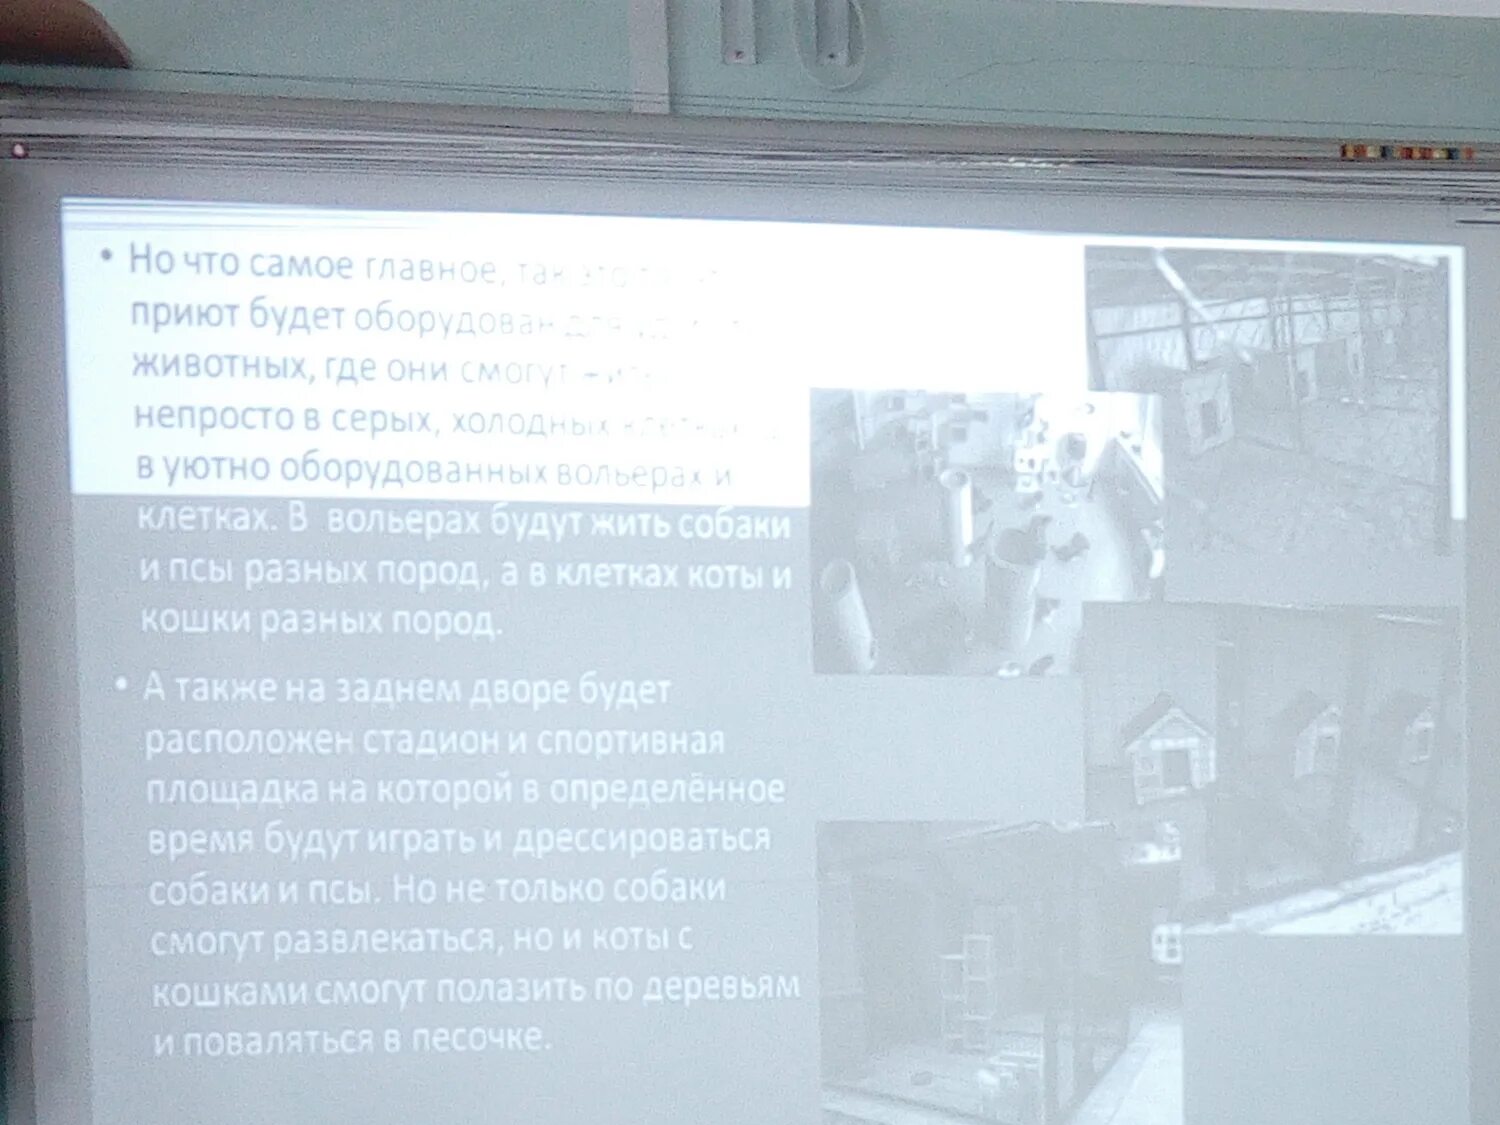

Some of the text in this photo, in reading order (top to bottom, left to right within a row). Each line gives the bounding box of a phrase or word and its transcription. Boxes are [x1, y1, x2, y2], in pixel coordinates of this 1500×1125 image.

[130, 242, 175, 276] Но
[183, 250, 239, 277] что
[249, 251, 354, 280] самое
[366, 256, 505, 288] главное,
[131, 301, 239, 333] приют
[249, 296, 346, 335] будет
[355, 302, 554, 340] оборудован
[133, 352, 316, 384] животных,
[326, 358, 377, 385] где
[388, 358, 448, 382] они
[461, 361, 565, 388] смогут
[135, 404, 294, 436] непросто
[304, 408, 321, 431] в
[332, 409, 440, 438] серых,
[452, 411, 609, 439] холодных
[138, 449, 731, 492] в уютно оборудованных вольерах и
[138, 500, 791, 544] клетках. В вольерах будут жить собаки
[141, 557, 791, 594] и псы разных пород, а в клетках коты и
[142, 607, 503, 642] кошки разных пород.
[144, 670, 670, 712] А также на заднем дворе будет
[146, 728, 724, 759] расположен стадион и спортивная
[148, 771, 785, 810] площадка на которой в определённое
[149, 821, 771, 863] время будут играть и дрессироваться
[151, 869, 725, 907] собаки и псы. Но не только собаки
[152, 926, 693, 961] смогут развлекаться, но и коты с
[154, 974, 800, 1012] кошками смогут полазить по деревьям
[155, 1024, 552, 1056] и поваляться в песочке.
